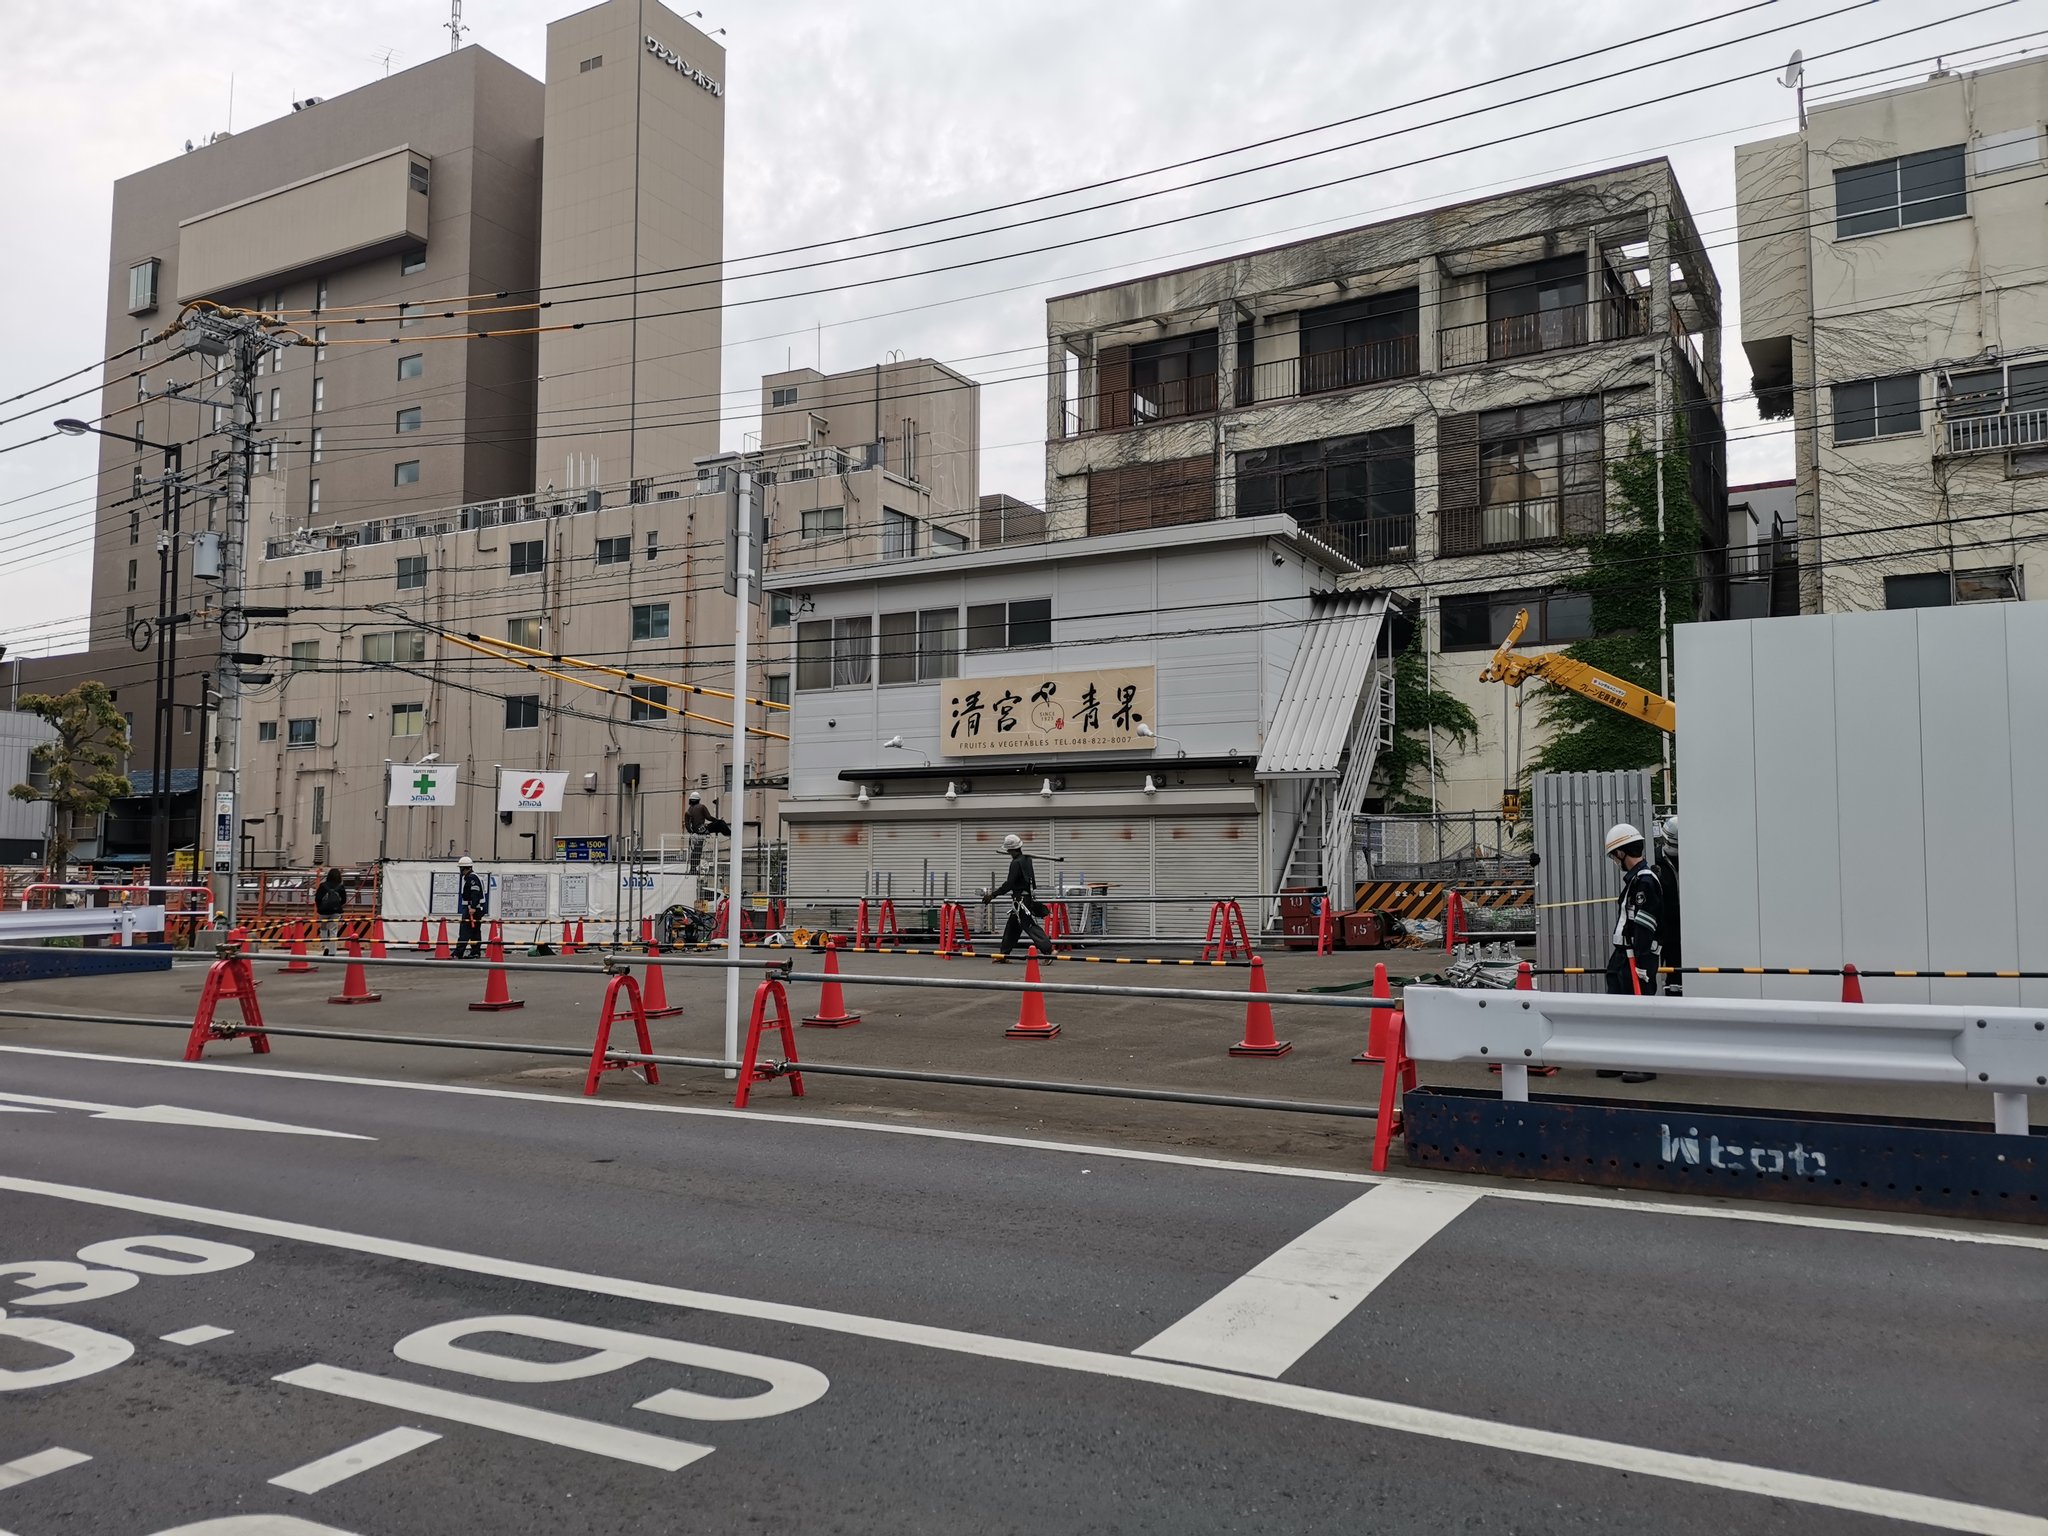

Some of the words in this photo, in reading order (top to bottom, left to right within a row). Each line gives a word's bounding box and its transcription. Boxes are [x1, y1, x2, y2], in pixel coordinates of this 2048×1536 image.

[646, 34, 724, 97] ワシントンホテル
[959, 741, 987, 750] FRUITS
[998, 739, 1049, 748] VEGETABLES
